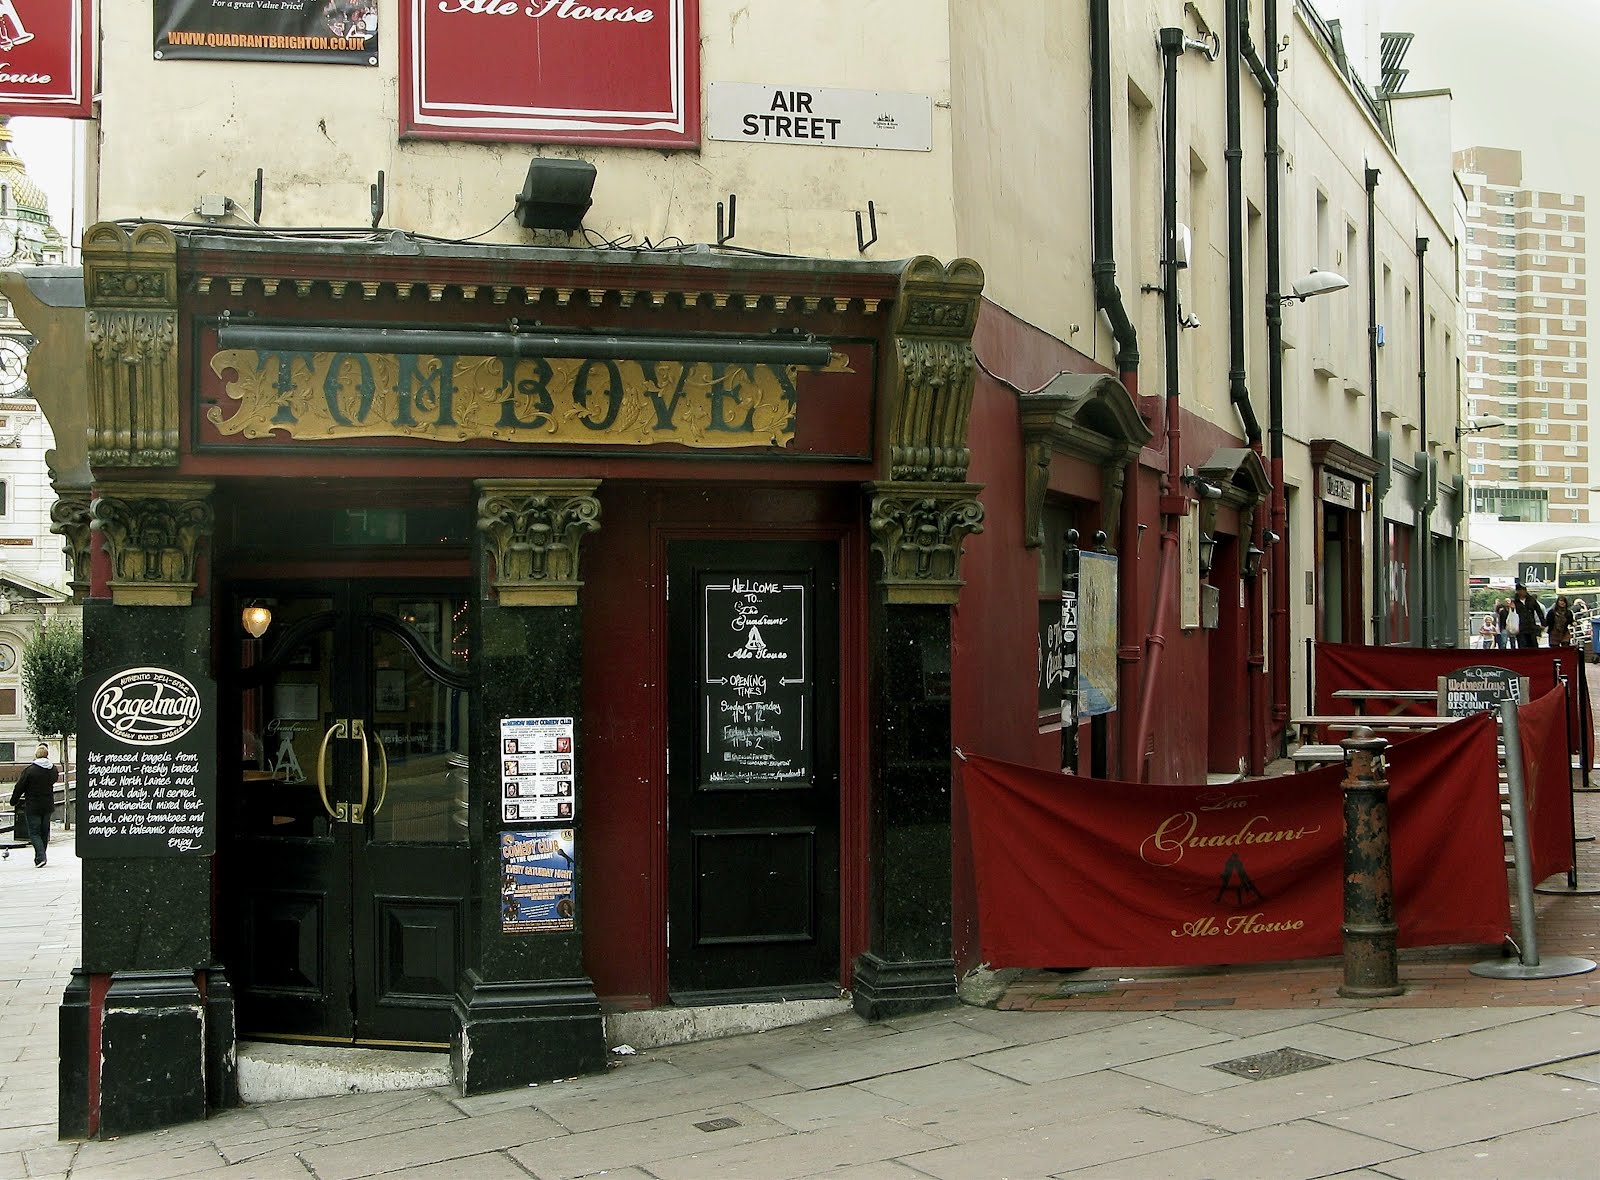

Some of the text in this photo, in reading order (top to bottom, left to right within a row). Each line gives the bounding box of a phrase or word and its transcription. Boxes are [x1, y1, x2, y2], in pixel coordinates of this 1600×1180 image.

[233, 1, 254, 10] great
[256, 1, 279, 10] Value
[280, 2, 304, 10] Price!
[168, 31, 365, 50] WWW.QUADRANTBRIGHTON.CO.UK
[0, 62, 51, 84] ouse
[770, 90, 813, 114] AIR
[742, 114, 841, 140] STREET
[731, 578, 781, 593] WELCOME
[731, 615, 788, 631] Quadrant
[727, 648, 788, 659] Ale House
[729, 674, 766, 693] OPENING
[1448, 678, 1506, 698] Wednesdays
[733, 687, 761, 698] TIMES
[1448, 692, 1477, 701] ODEON
[95, 683, 198, 730] Bagelman
[1448, 701, 1490, 710] DISCOUNT
[161, 726, 184, 739] BAGELS
[88, 751, 198, 765] Hot pressed bagels from
[88, 764, 132, 776] Bagelman
[140, 763, 168, 777] freshly
[171, 763, 199, 774] baked
[89, 775, 194, 787] in the North Laines and
[88, 787, 124, 798] delivered
[153, 788, 165, 798] All
[166, 787, 197, 798] served
[108, 799, 153, 811] continental
[156, 799, 180, 810] mixed
[183, 799, 204, 810] leaf
[118, 813, 145, 825] cherry
[146, 812, 187, 823] tomatoes
[189, 812, 205, 822] and
[88, 825, 118, 837] orange
[120, 825, 127, 834] &
[129, 825, 166, 835] balsamic
[168, 838, 202, 851] Enjoy
[1140, 811, 1321, 866] Quadrant
[503, 841, 536, 858] COMEDY
[538, 840, 560, 853] CLUB
[505, 864, 573, 879] EVERY SATURDAY NIGHT
[1171, 912, 1304, 938] Ale House
